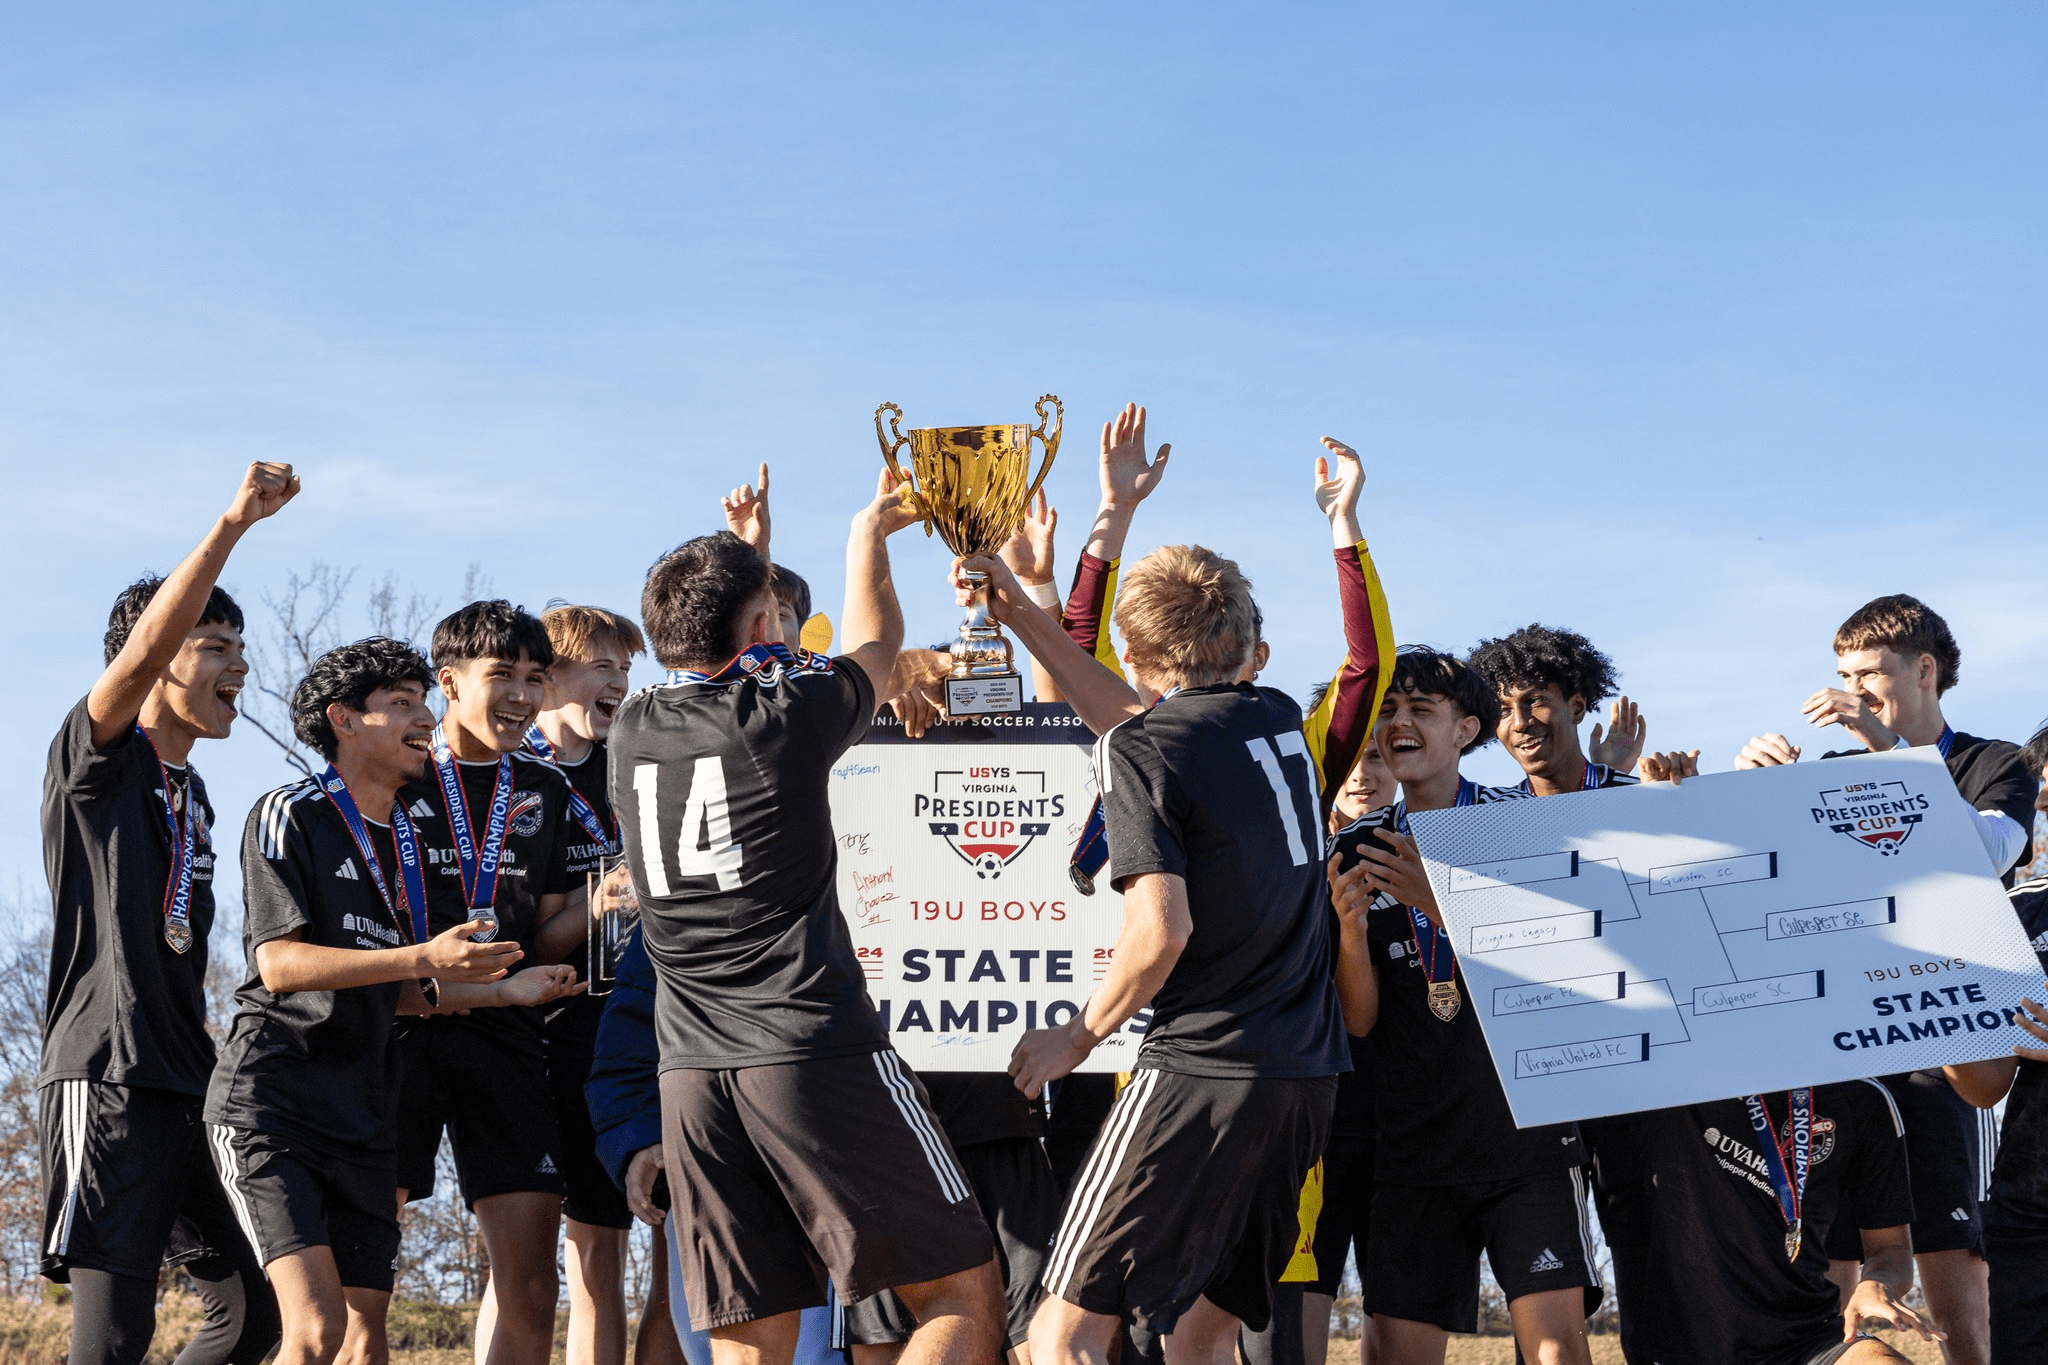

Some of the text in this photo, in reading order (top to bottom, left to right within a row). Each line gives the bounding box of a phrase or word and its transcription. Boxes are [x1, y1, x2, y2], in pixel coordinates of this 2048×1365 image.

[970, 767, 1010, 778] USYS
[962, 784, 1017, 793] VIRGINIA
[1844, 793, 1888, 803] VIRGINIA
[1845, 782, 1878, 793] USYS
[442, 767, 468, 834] PRESIDENTS
[459, 836, 473, 861] CUP
[914, 793, 1065, 817] PRESIDENTS
[1811, 794, 1930, 824] PRESIDENTS
[481, 782, 511, 873] CHAMPIONS
[633, 755, 743, 897] 14
[964, 821, 1015, 838] CUP
[1858, 816, 1897, 831] CUP
[401, 842, 415, 867] CUP
[172, 834, 194, 918] HAMPIONS
[1716, 867, 1734, 878] SC
[911, 901, 1067, 921] 19U BOYS
[355, 916, 399, 945] UVAHealth
[857, 947, 883, 958] 24
[902, 949, 1074, 982] STATE
[1864, 958, 1967, 982] 19U BOYS
[1559, 987, 1578, 998] FC
[1765, 982, 1791, 997] SC
[1872, 983, 1987, 1016] STATE
[1833, 1003, 2044, 1051] CHAMPION
[1562, 1044, 1602, 1064] United
[1605, 1043, 1628, 1058] FC
[1530, 1261, 1564, 1273] adidas
